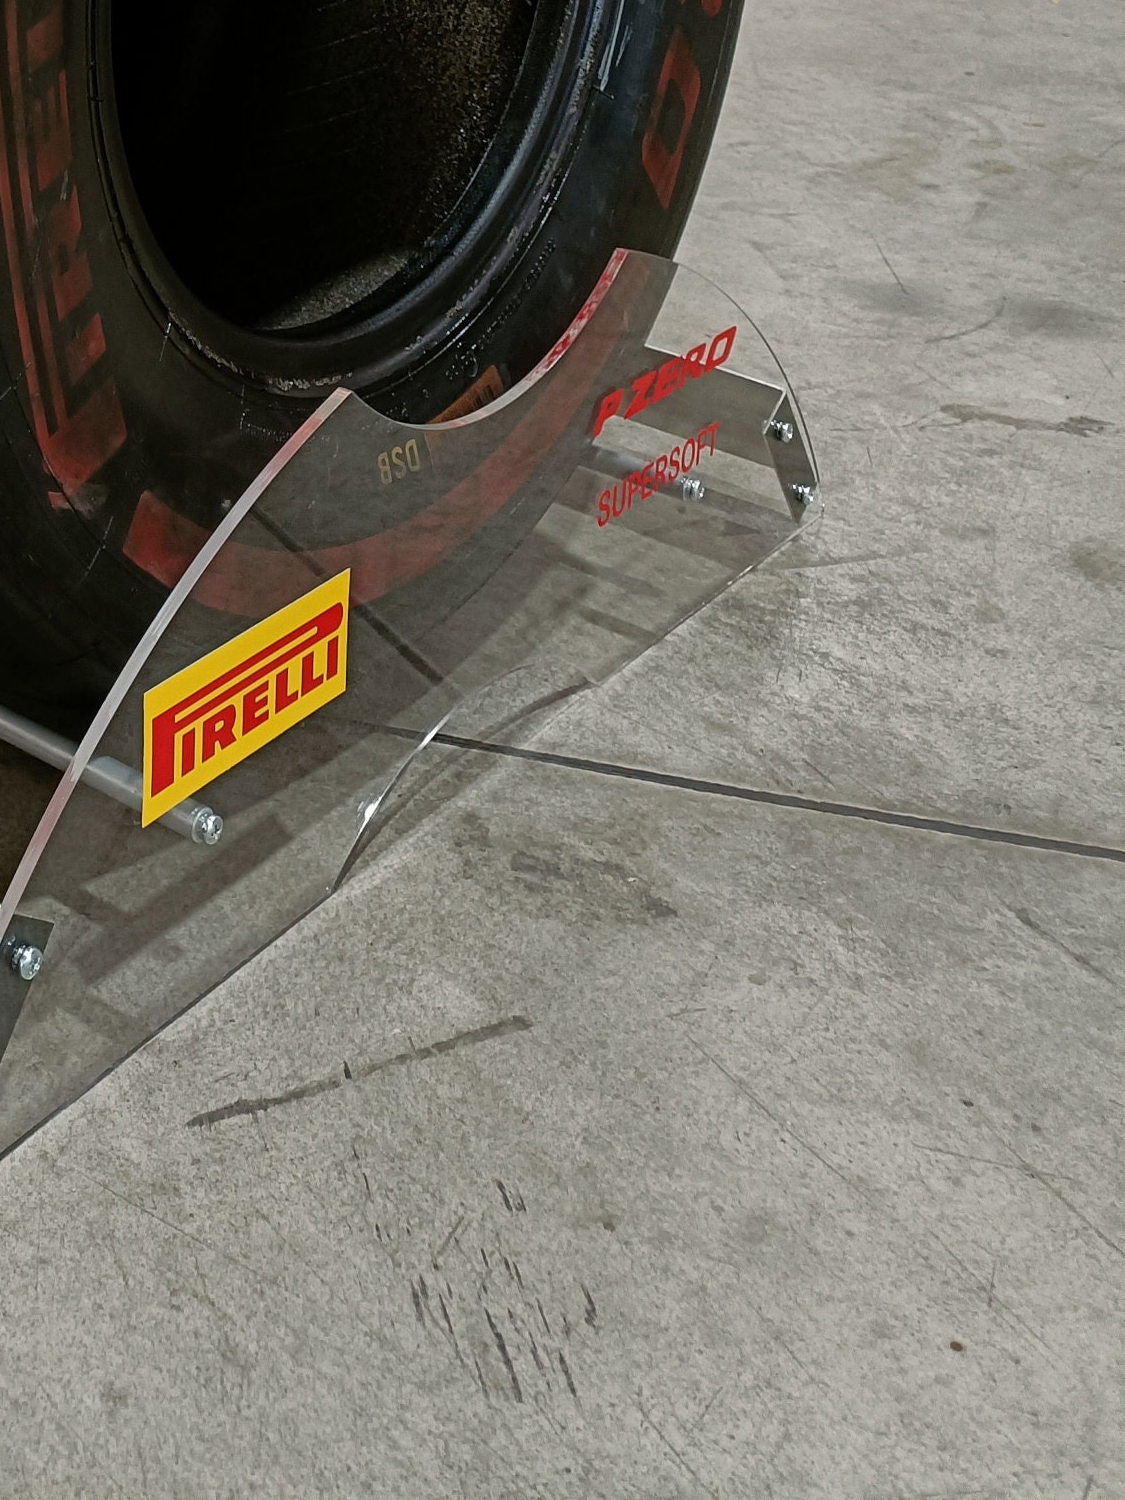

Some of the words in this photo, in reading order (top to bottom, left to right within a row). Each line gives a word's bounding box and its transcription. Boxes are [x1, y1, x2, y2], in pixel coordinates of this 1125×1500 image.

[592, 388, 624, 438] P
[621, 325, 738, 417] ZERO
[377, 438, 421, 486] DSB
[596, 422, 720, 527] SUPERSOFT
[150, 601, 344, 797] PIRELLI
